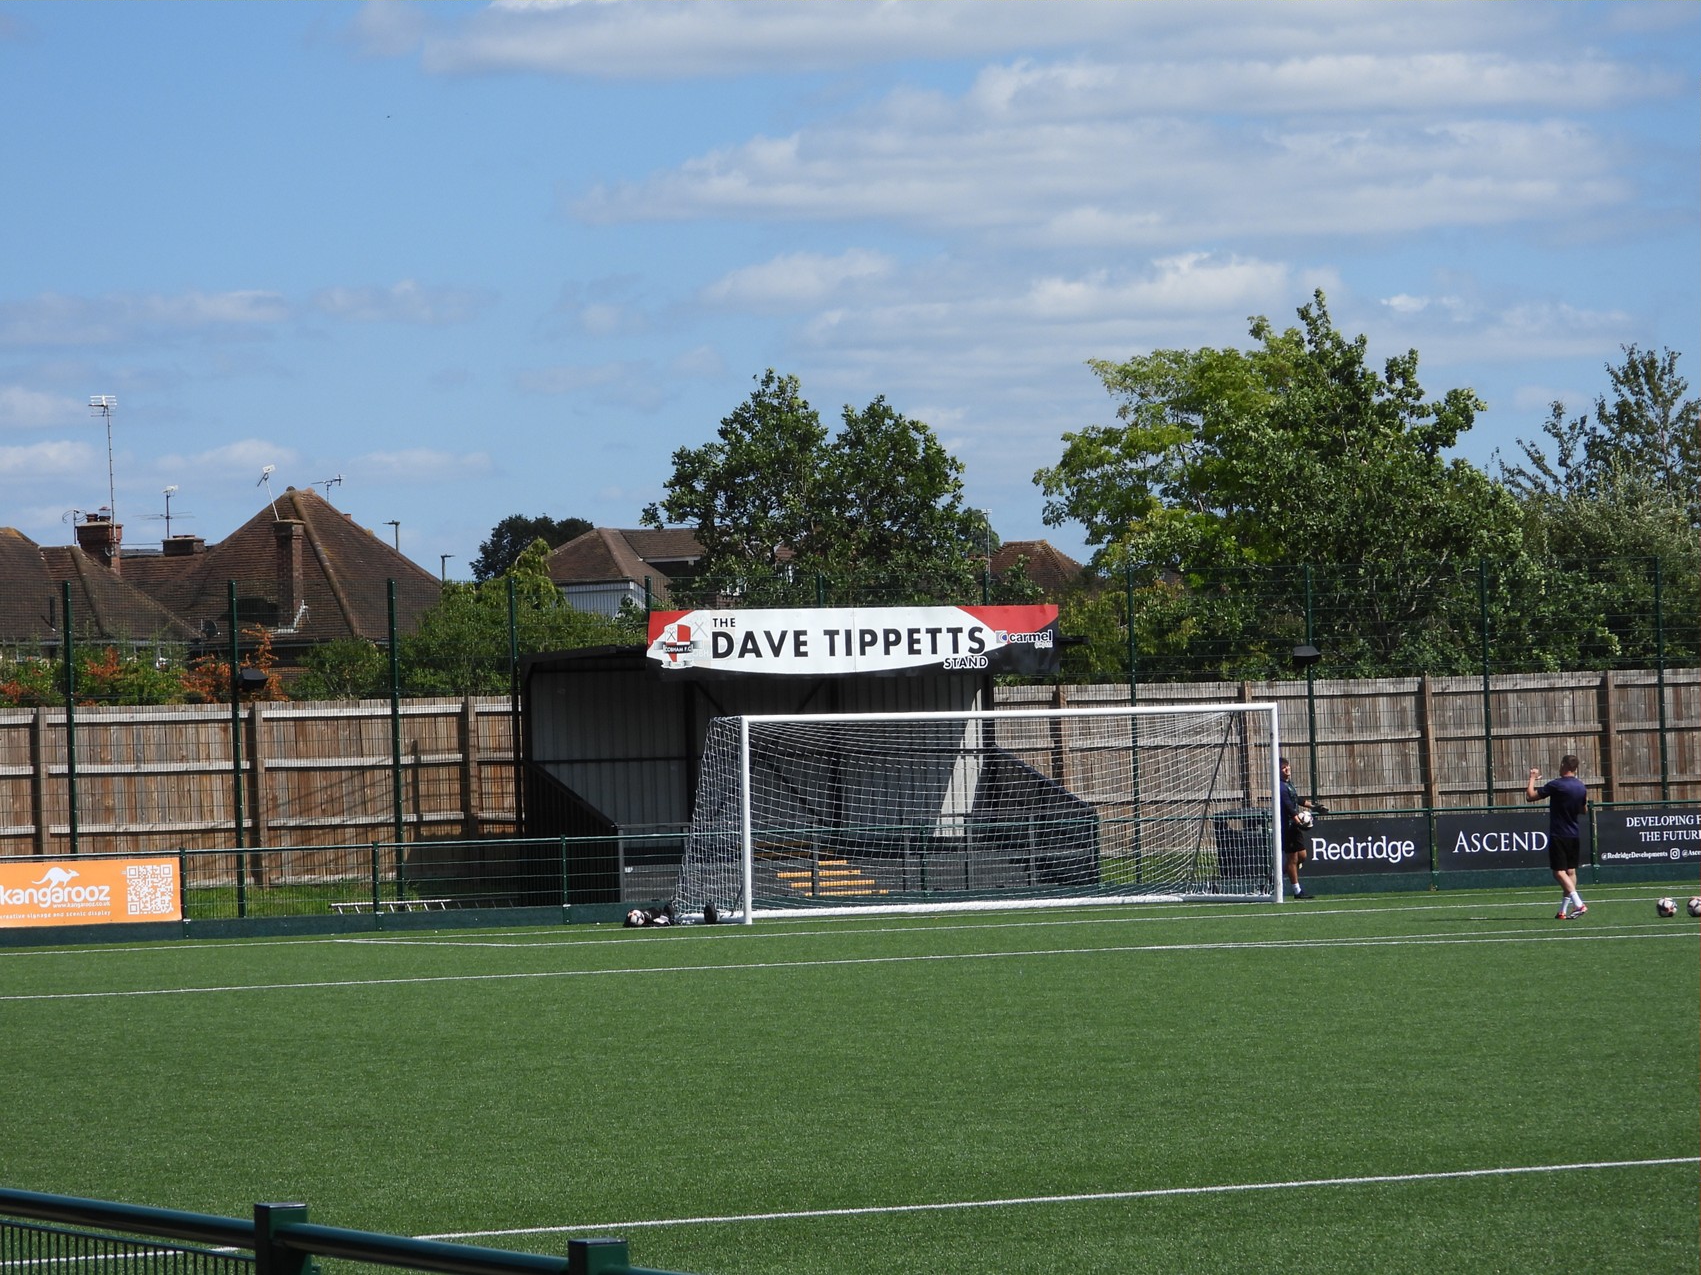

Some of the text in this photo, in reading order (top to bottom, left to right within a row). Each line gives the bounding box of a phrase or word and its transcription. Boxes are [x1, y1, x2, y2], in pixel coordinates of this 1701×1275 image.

[712, 618, 736, 628] THE
[712, 626, 986, 659] DAVE TIPPETTS
[1009, 629, 1053, 643] carmel
[943, 656, 988, 669] STAND
[1626, 815, 1694, 827] DEVELOPING
[1453, 830, 1548, 854] ASCEND
[1639, 831, 1661, 842] THE
[1311, 835, 1415, 864] Redridge
[0, 885, 111, 909] kangarooz
[52, 901, 111, 910] www.kangarooz.co.uk
[27, 912, 52, 920] signage
[88, 910, 111, 918] display
